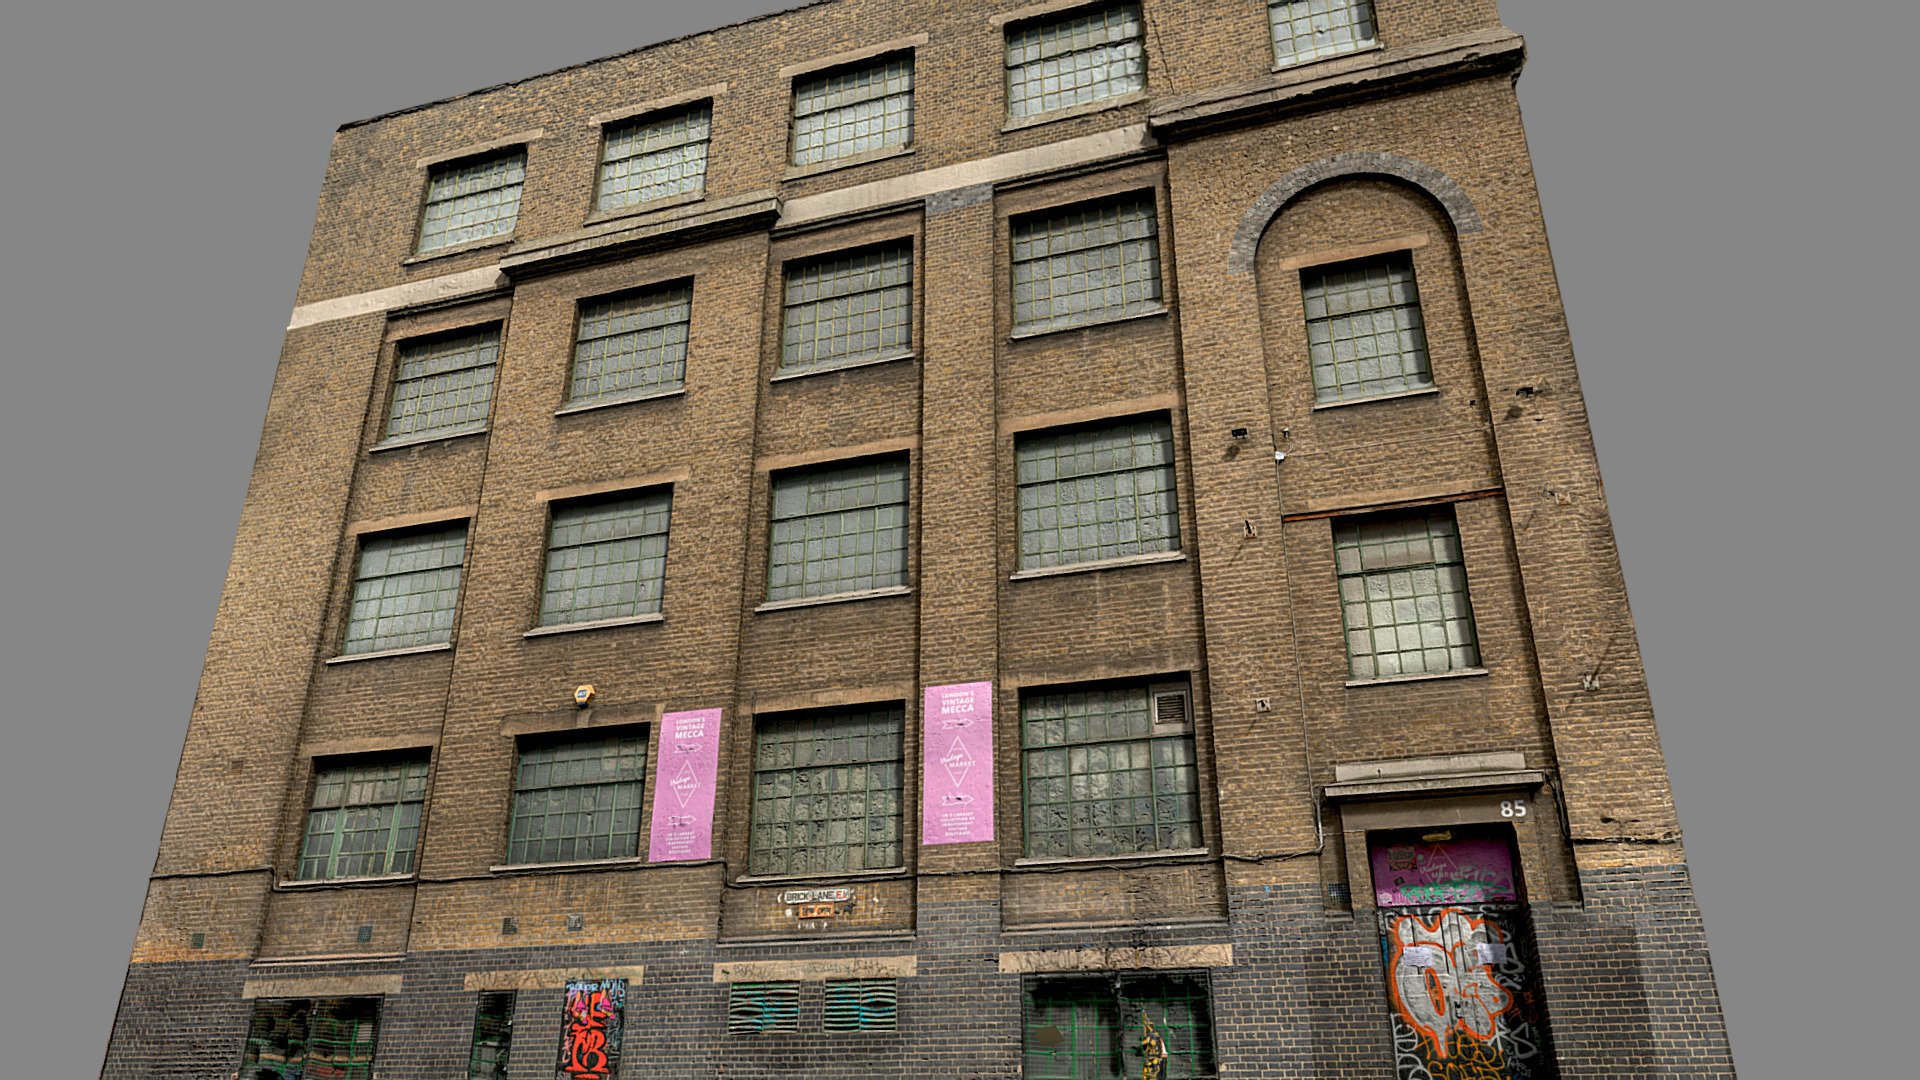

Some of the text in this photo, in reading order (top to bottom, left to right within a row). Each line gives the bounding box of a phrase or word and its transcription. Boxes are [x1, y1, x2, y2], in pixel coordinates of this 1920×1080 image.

[942, 697, 974, 706] VINTAGE
[941, 703, 974, 714] MECCA
[676, 723, 704, 731] VINTAGE
[675, 730, 704, 740] MECCA
[1500, 800, 1527, 818] 85
[786, 892, 809, 901] BRICK
[812, 891, 834, 900] LANE
